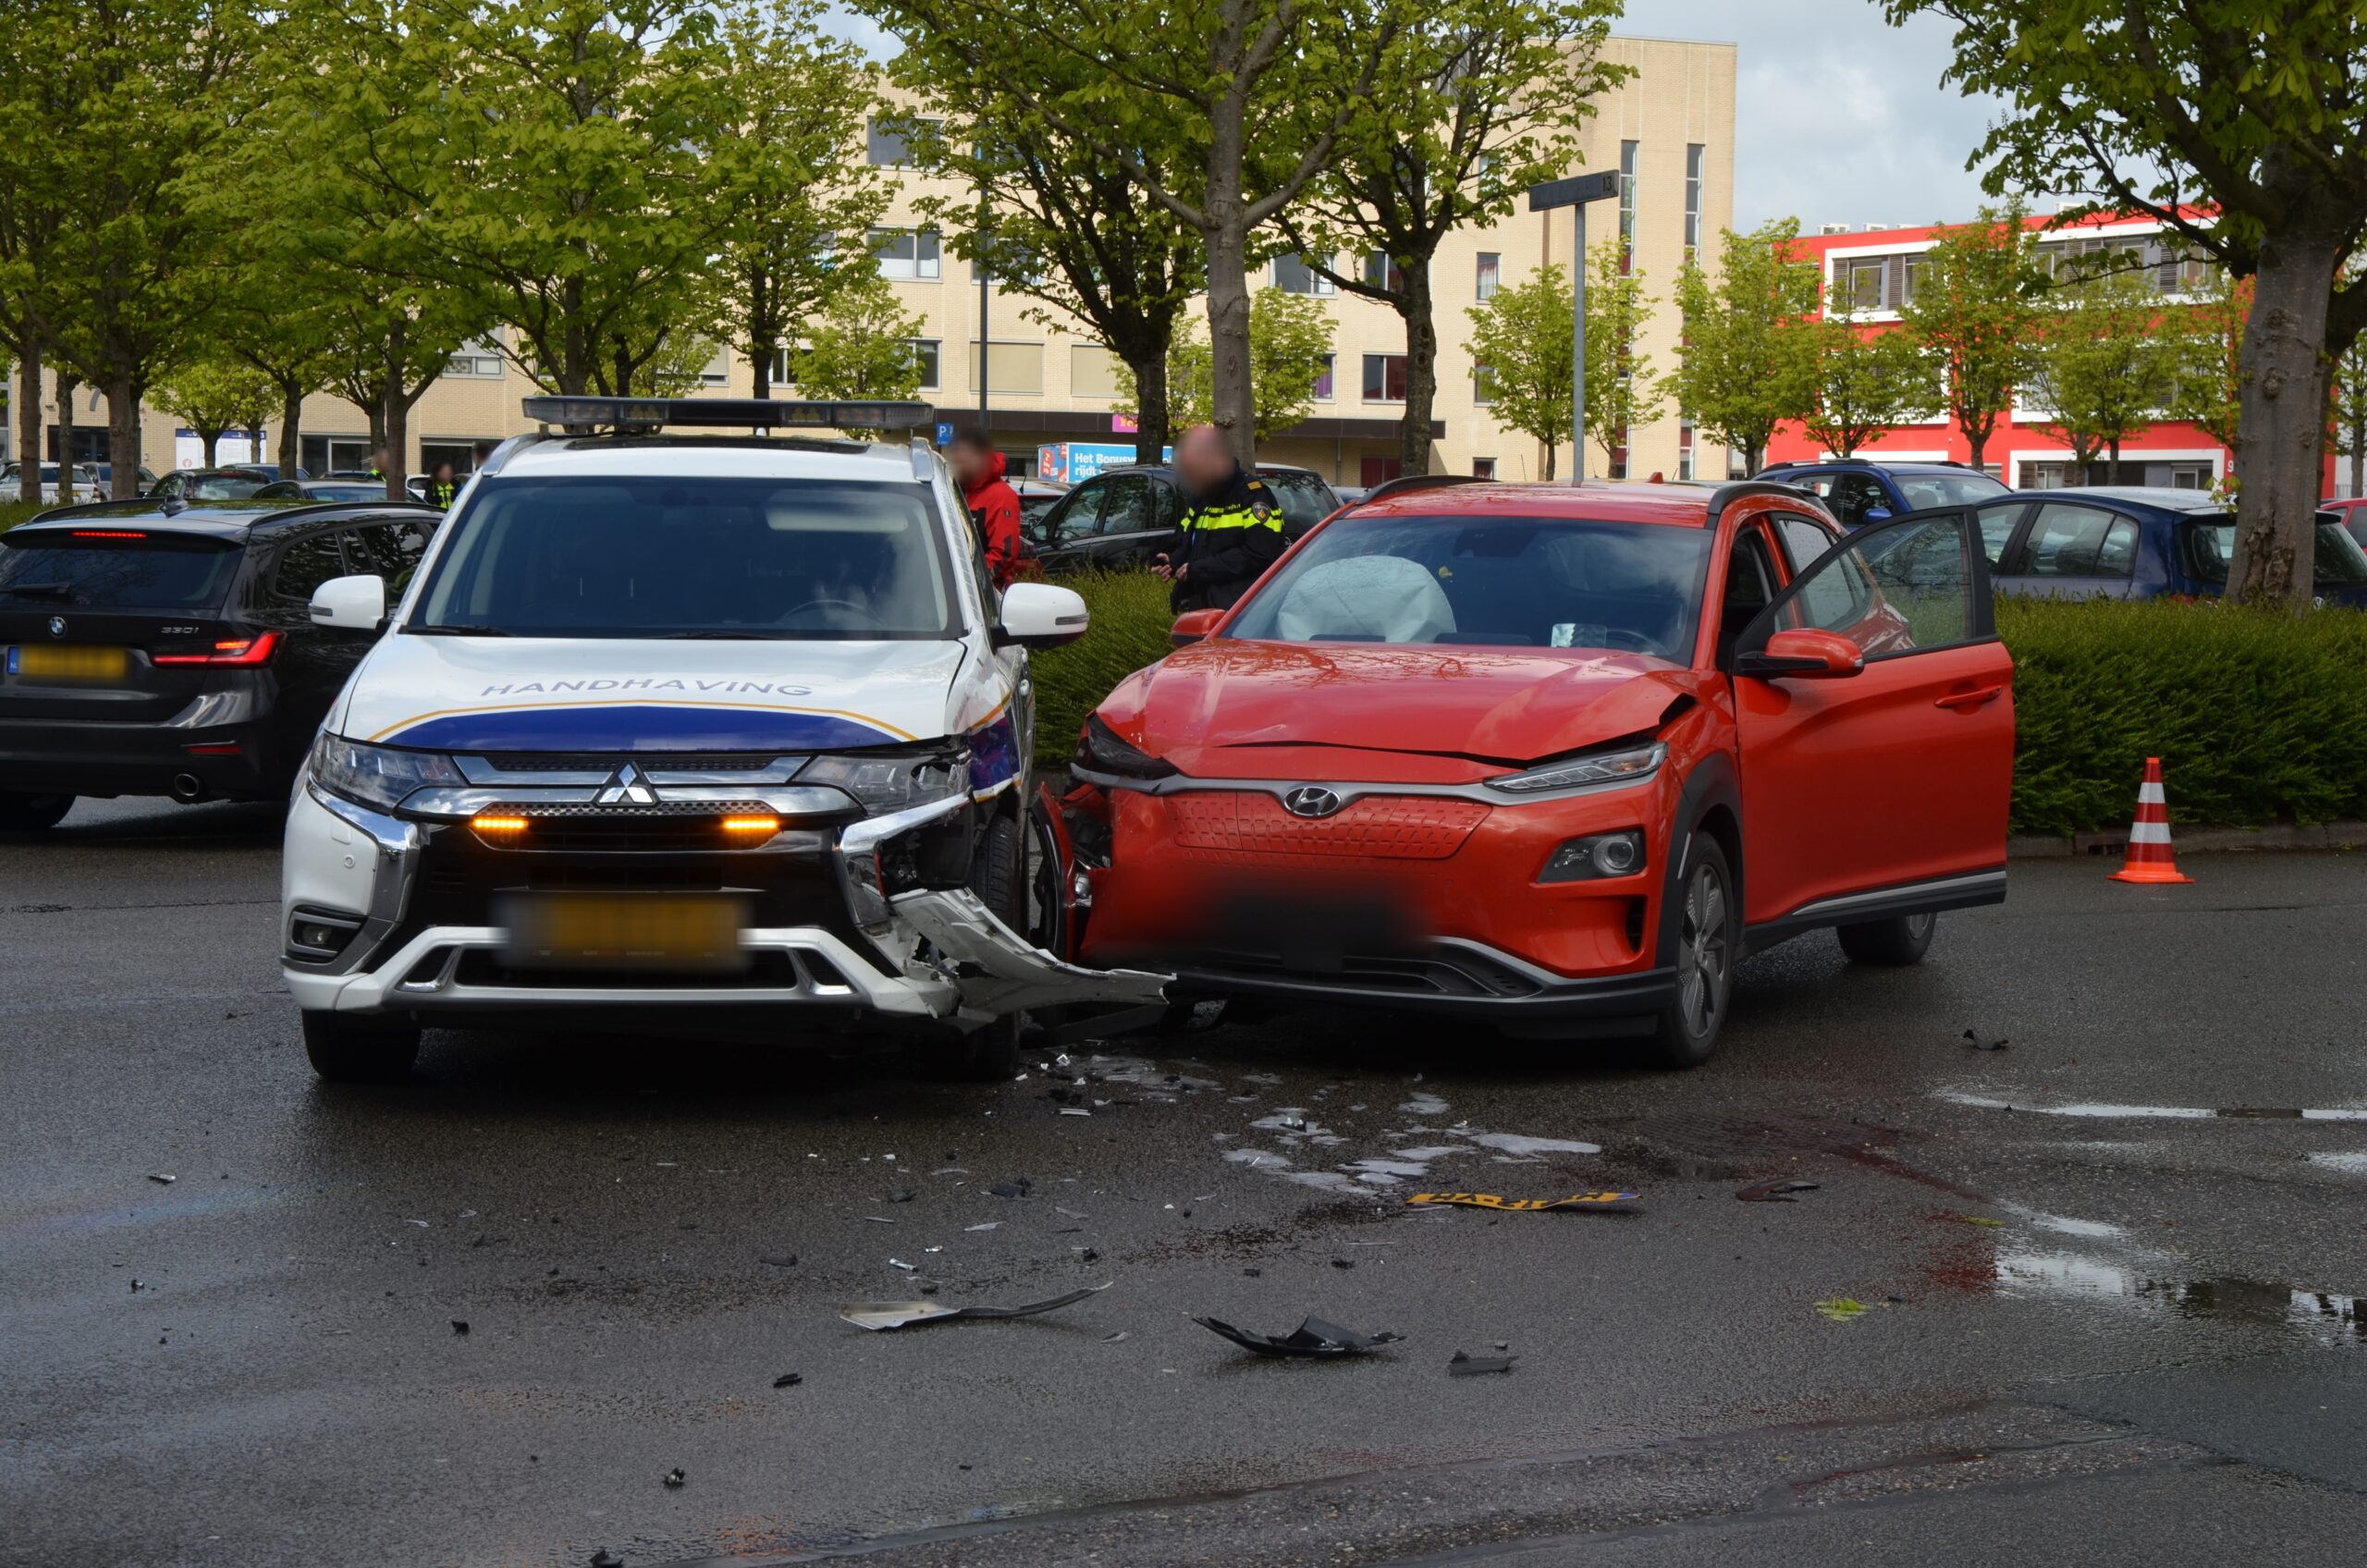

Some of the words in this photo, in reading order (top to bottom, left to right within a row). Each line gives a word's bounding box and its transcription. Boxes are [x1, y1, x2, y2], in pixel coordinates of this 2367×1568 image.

[1602, 176, 1613, 192] 13
[939, 425, 947, 437] P
[1074, 452, 1094, 463] Het
[1074, 465, 1097, 478] rijdt
[480, 678, 814, 696] HANDHAVING
